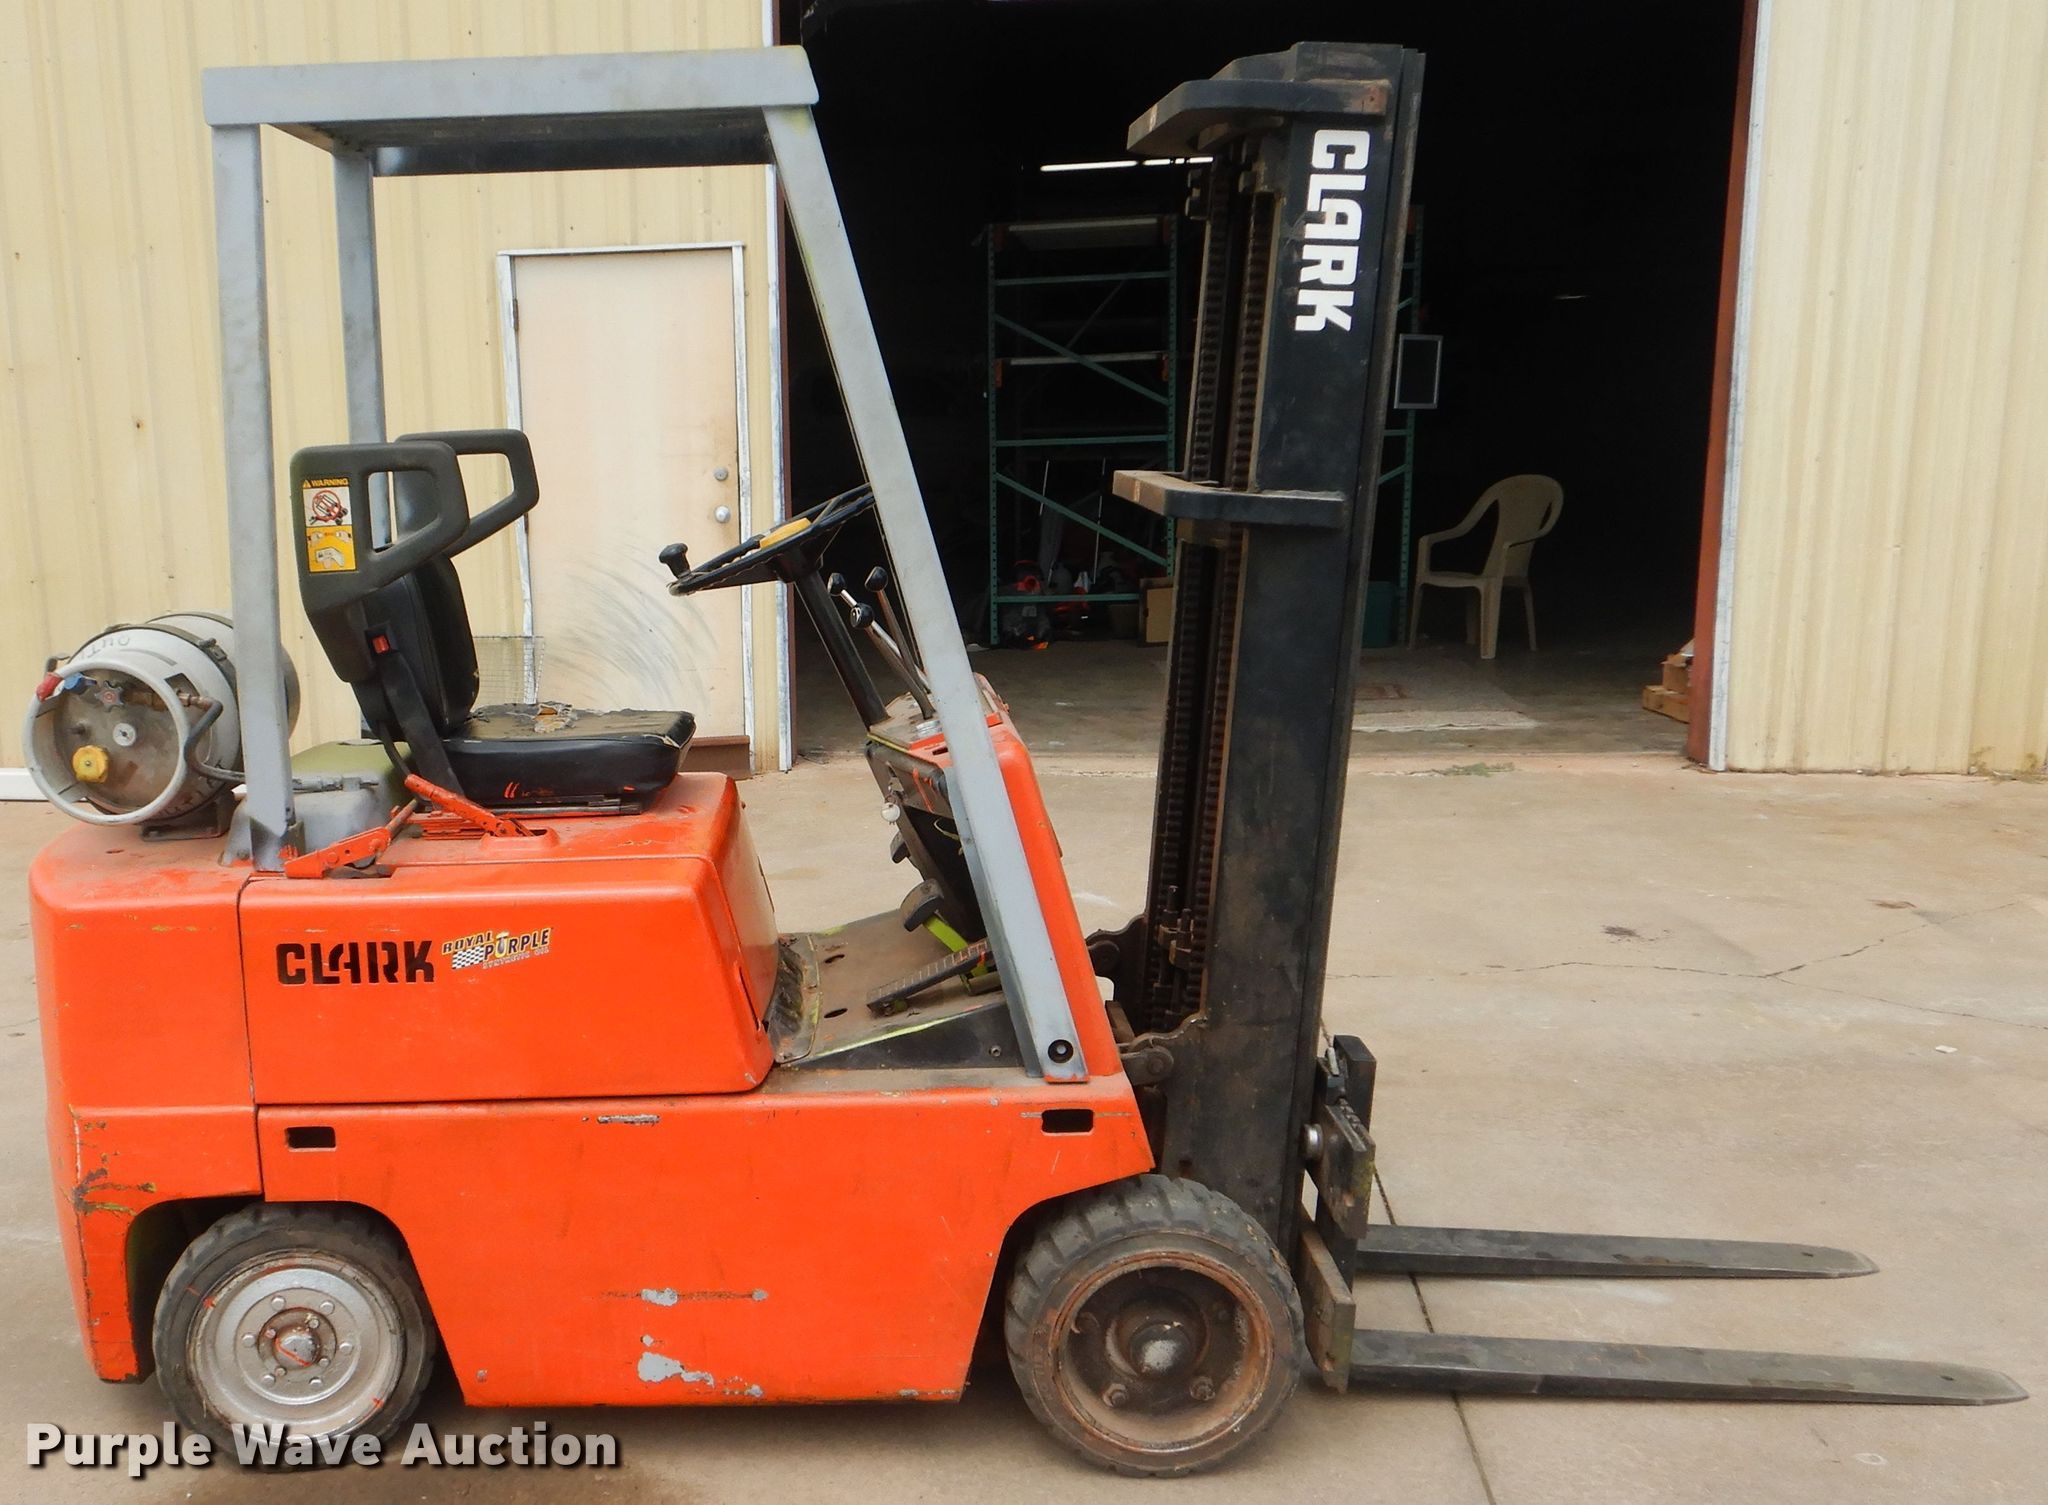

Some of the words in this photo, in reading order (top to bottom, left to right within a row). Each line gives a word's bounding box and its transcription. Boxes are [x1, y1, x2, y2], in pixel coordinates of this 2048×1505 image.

[1295, 129, 1370, 332] CLARK
[311, 478, 348, 487] WARNING
[442, 931, 493, 955] ROYAL
[483, 928, 551, 961] PURPLE
[276, 940, 434, 985] CLARK
